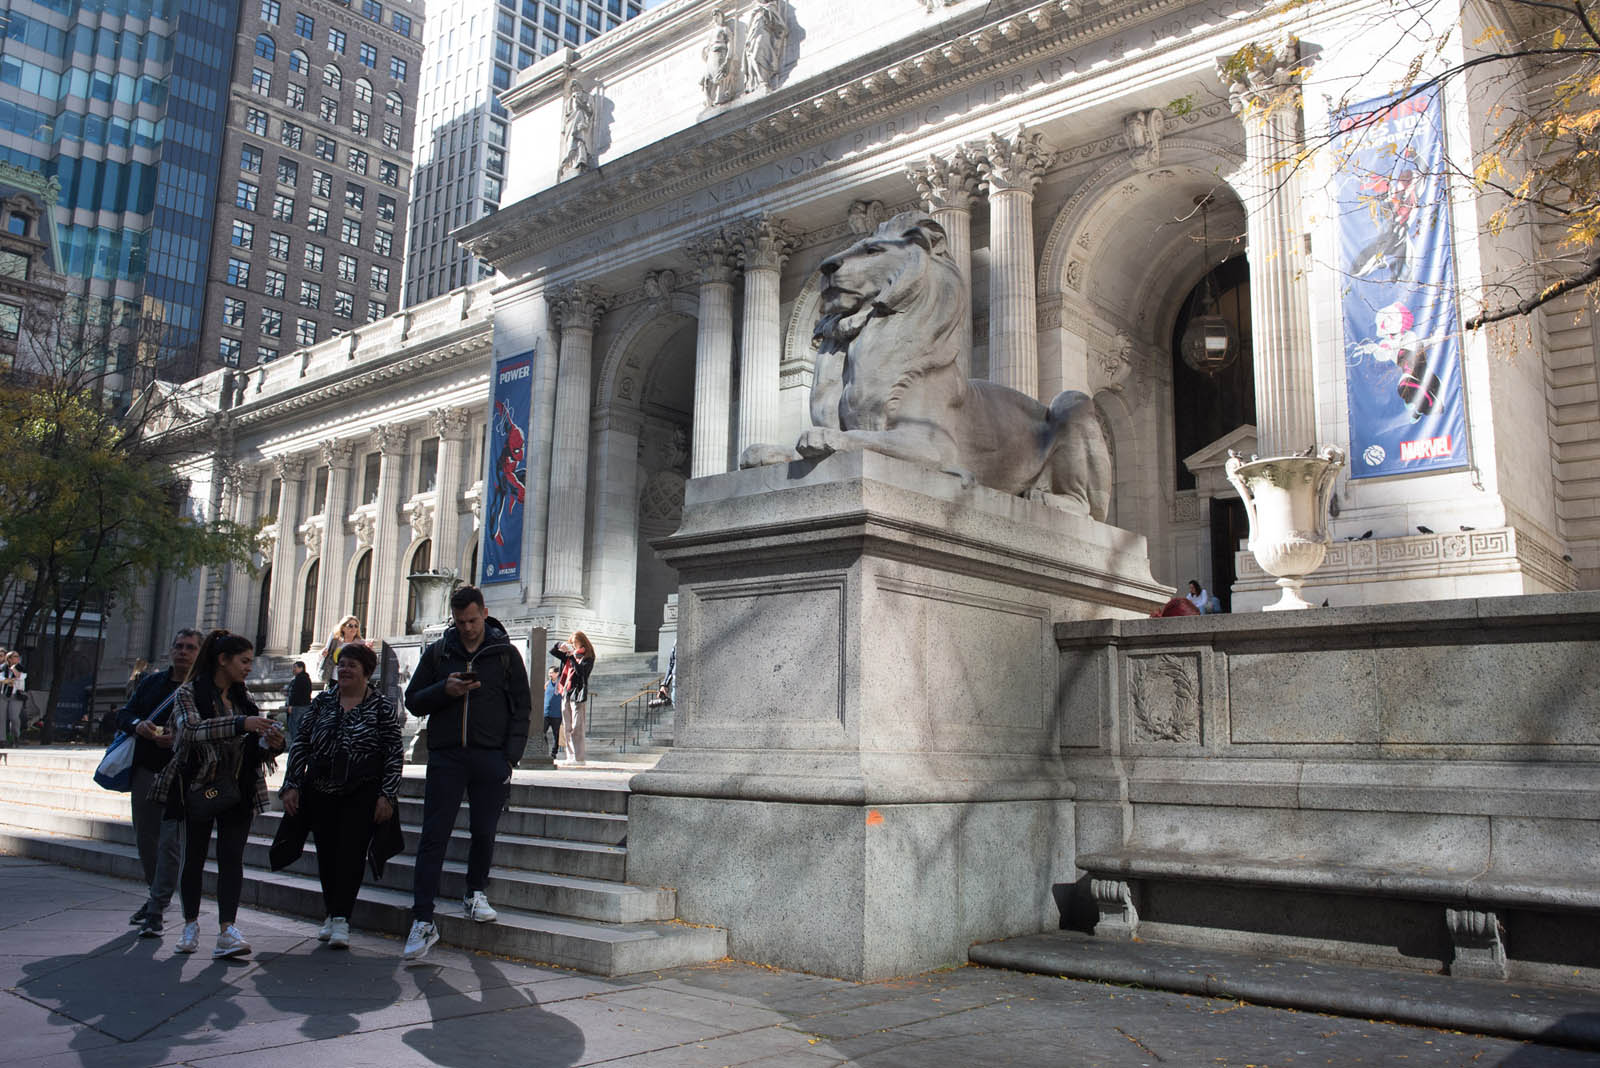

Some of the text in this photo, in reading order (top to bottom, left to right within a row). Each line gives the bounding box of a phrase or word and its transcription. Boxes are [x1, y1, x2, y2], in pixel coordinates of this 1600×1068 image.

[706, 175, 756, 204] NEW
[776, 146, 833, 181] YORK
[854, 105, 940, 149] PUBLIC
[966, 54, 1083, 110] LIBRARY
[499, 365, 530, 385] POWER
[1400, 437, 1452, 461] MARVEL
